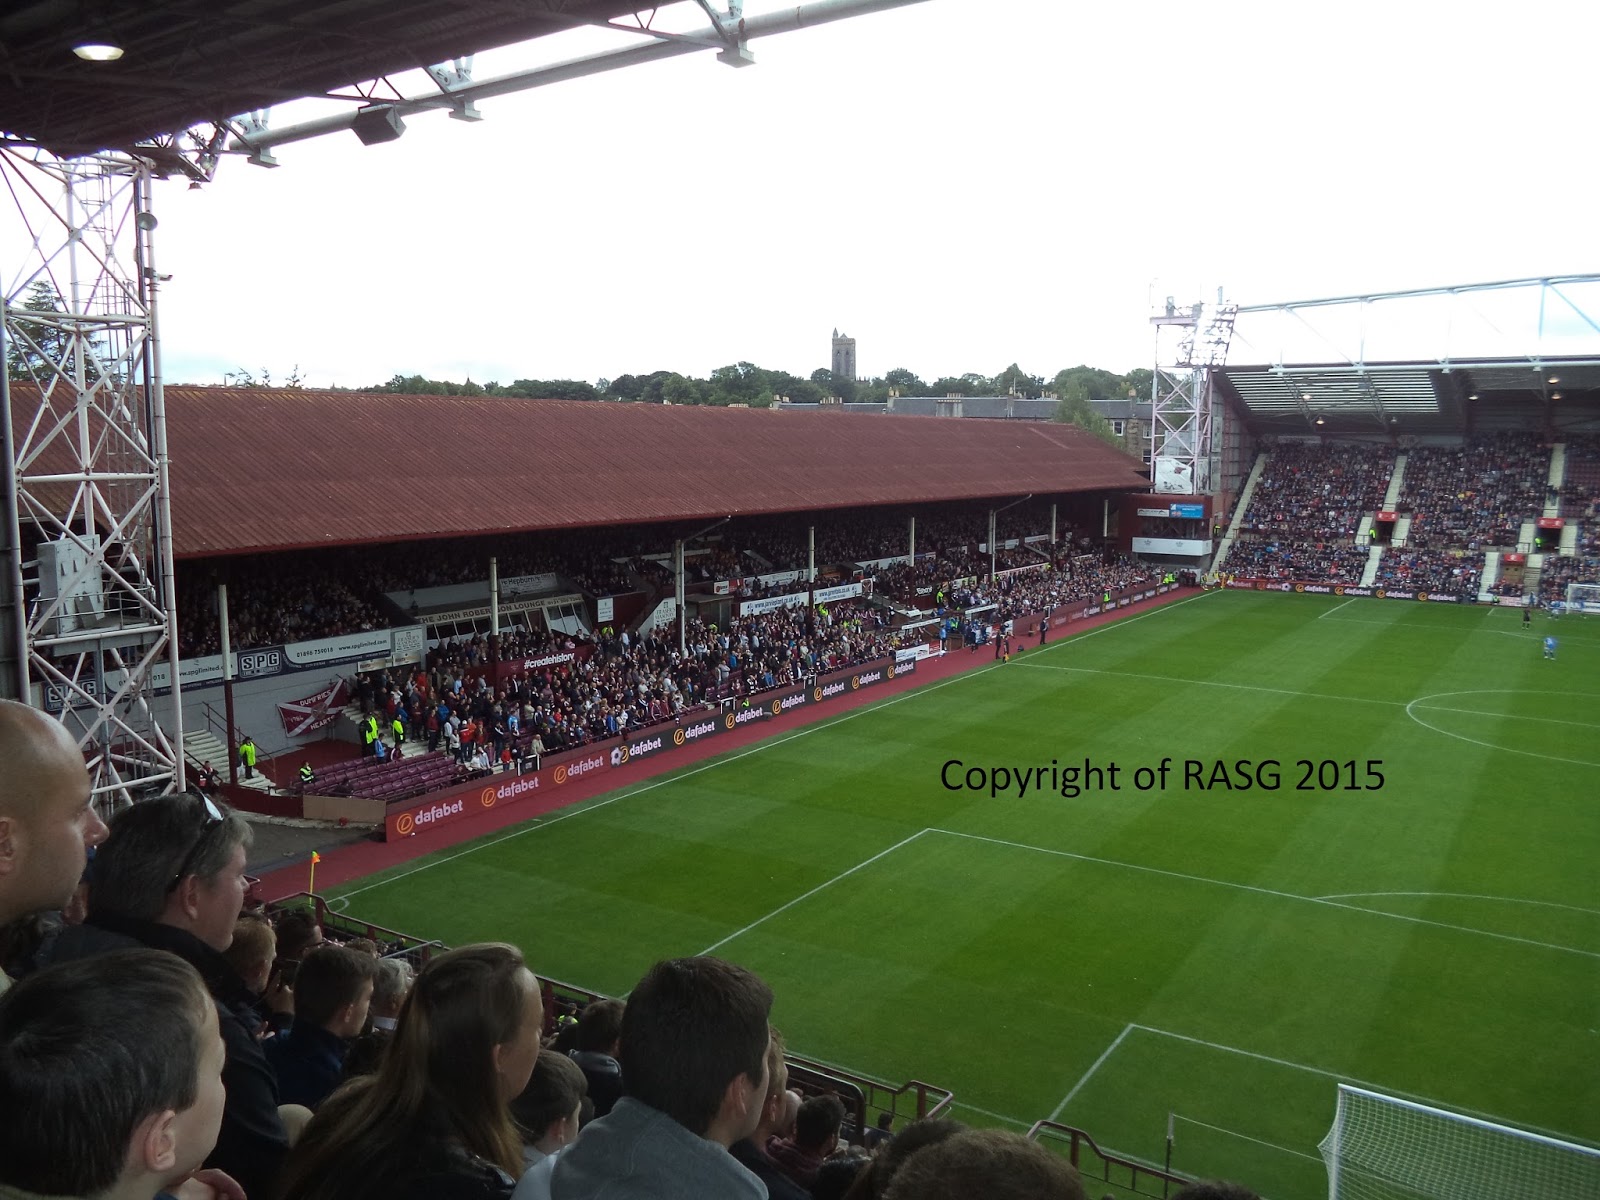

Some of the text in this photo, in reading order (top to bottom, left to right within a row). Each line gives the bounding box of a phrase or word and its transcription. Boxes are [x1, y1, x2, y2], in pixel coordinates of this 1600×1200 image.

[1304, 584, 1330, 594] dafabet
[1344, 587, 1371, 597] dafabet
[1385, 590, 1413, 600] dafabet
[1427, 593, 1457, 603] dafabet
[436, 611, 461, 622] JOHN
[463, 604, 513, 618] ROBERON
[514, 600, 546, 611] LOUNGE
[242, 653, 279, 670] SPG
[524, 652, 575, 670] #createhistory
[894, 662, 914, 675] dafabet
[179, 664, 233, 677] ww.spglimited.c
[859, 671, 881, 686] dafabet
[300, 689, 332, 706] DUMFRIES
[822, 682, 845, 698] dafabet
[781, 694, 806, 710] dafabet
[735, 706, 763, 724] dafabet
[685, 721, 715, 739] dafabet
[629, 737, 662, 756] dafabet
[567, 755, 604, 777] dafabet
[498, 777, 539, 799] dafabet
[415, 800, 464, 825] dafabet
